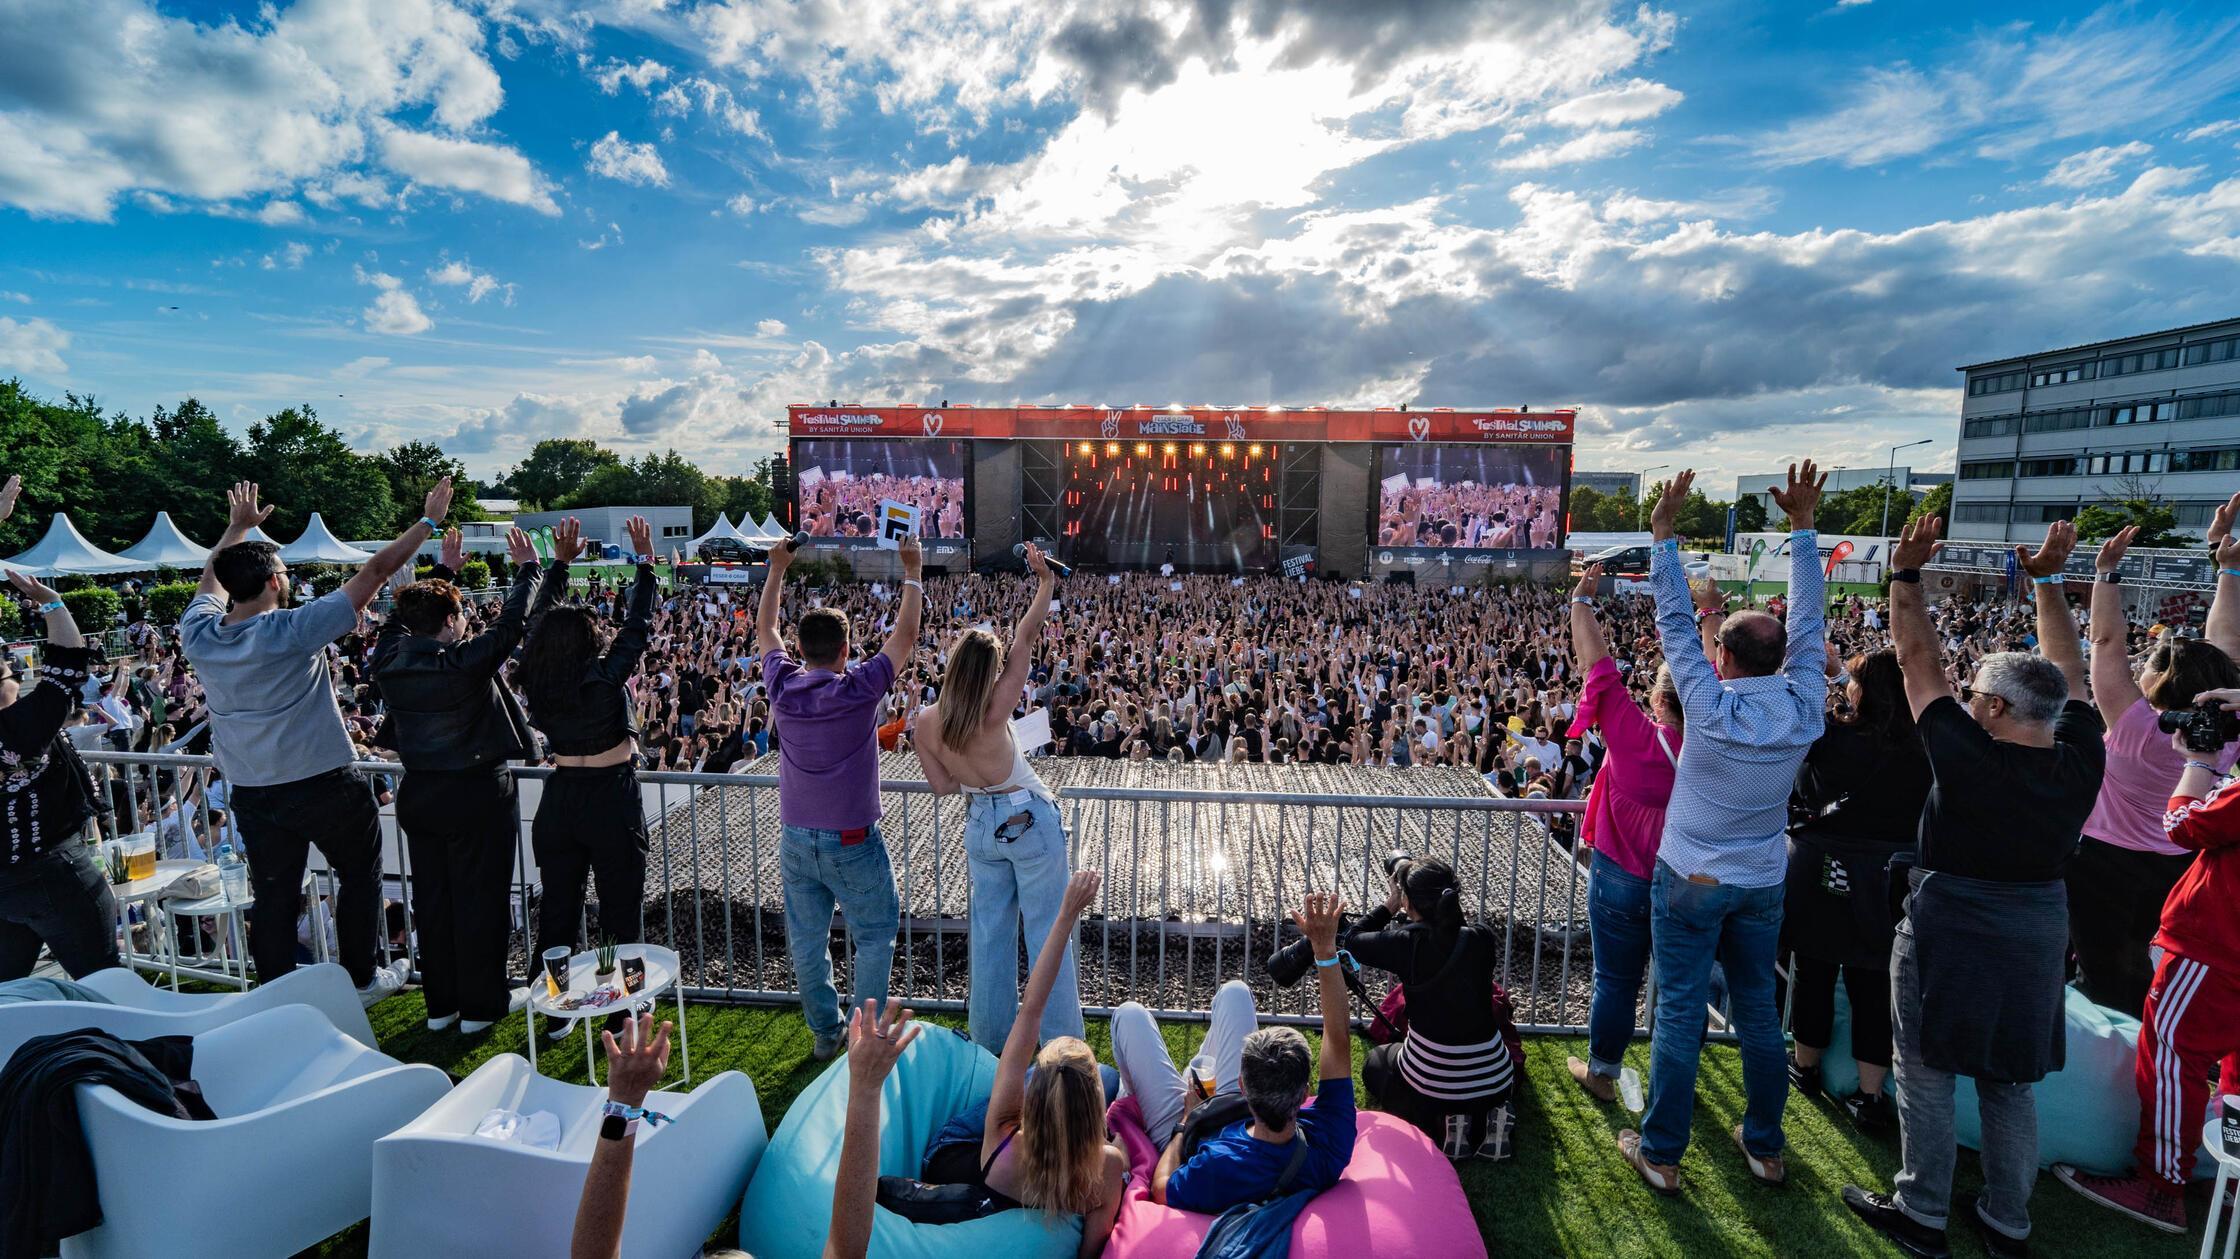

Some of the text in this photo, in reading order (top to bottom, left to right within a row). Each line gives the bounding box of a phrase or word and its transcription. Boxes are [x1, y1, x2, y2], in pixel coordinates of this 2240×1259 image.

[1495, 431, 1528, 439] SANITÄR
[1282, 553, 1313, 568] FESTIVAL
[1285, 565, 1305, 578] LIEBE
